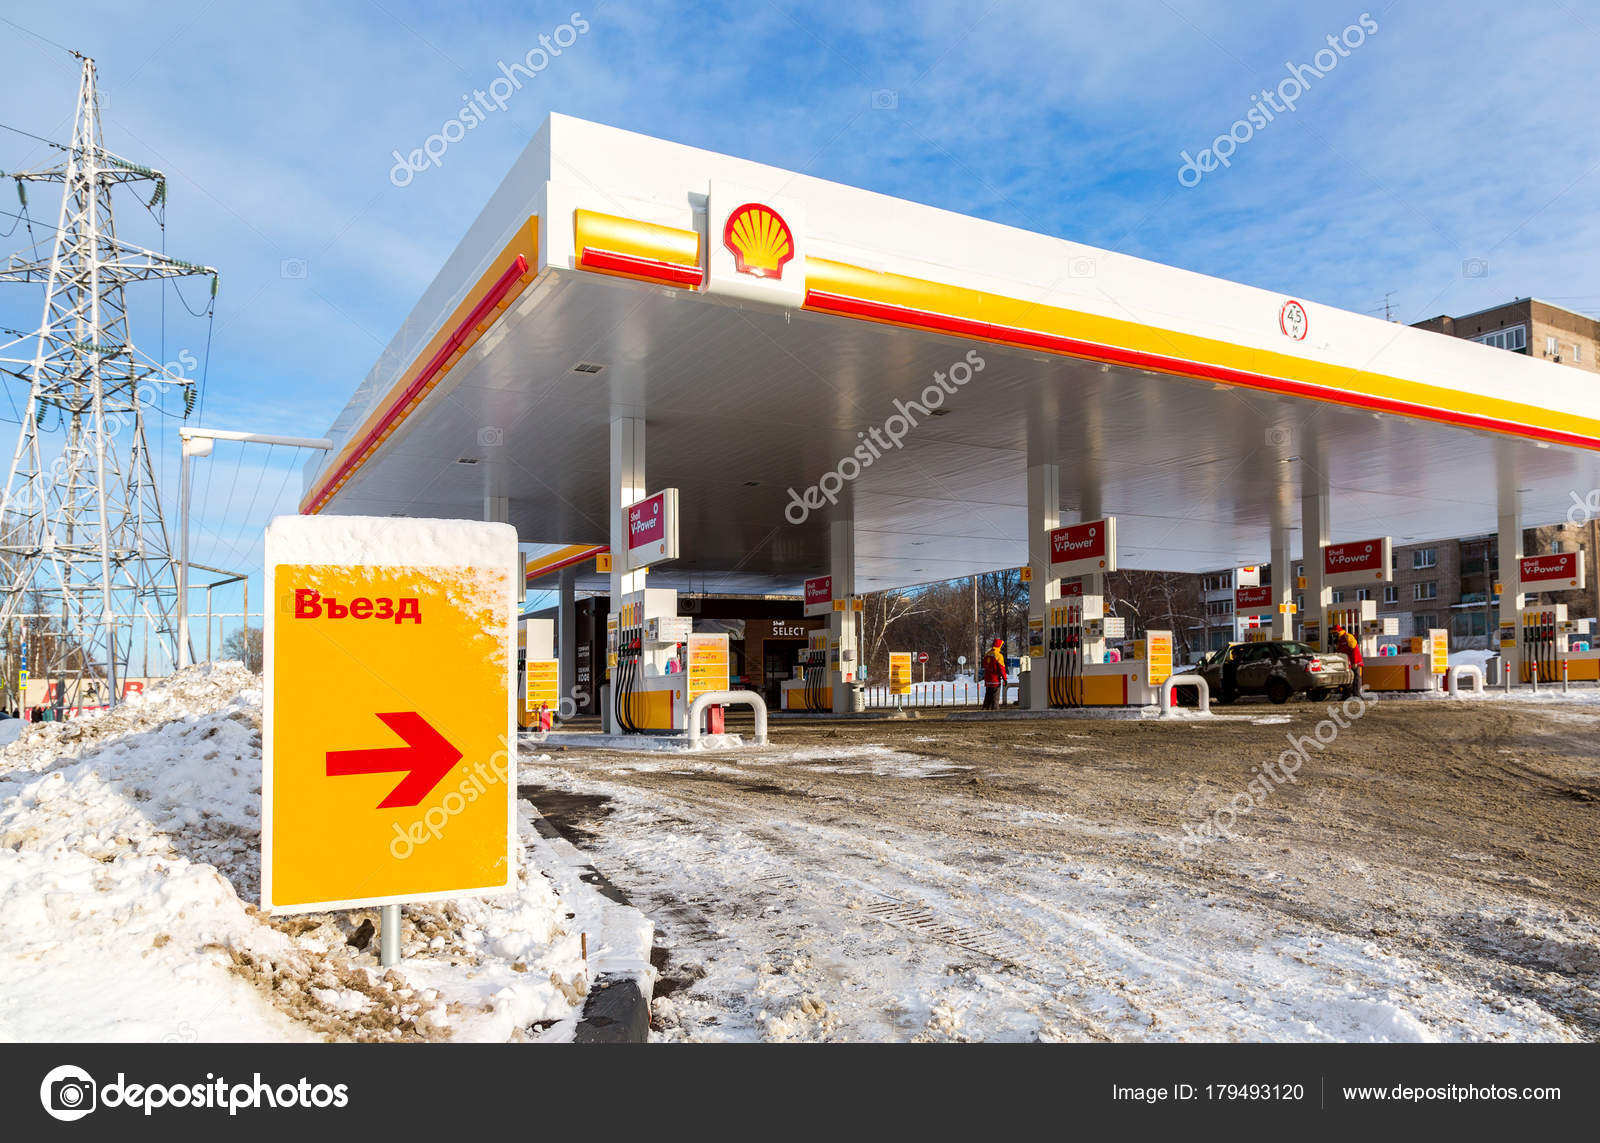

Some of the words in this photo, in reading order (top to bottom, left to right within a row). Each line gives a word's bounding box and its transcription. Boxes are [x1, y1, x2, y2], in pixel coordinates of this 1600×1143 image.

[630, 508, 641, 521] Shell
[630, 517, 657, 535] V-Power
[1054, 531, 1069, 543] Shell
[1054, 538, 1094, 553] V-Power
[1328, 547, 1345, 557] Shell
[1328, 553, 1371, 565] V-Power
[1523, 560, 1539, 568] Shell
[1523, 565, 1565, 575] V-Power
[294, 588, 422, 625] Въезд
[772, 627, 805, 636] SELECT
